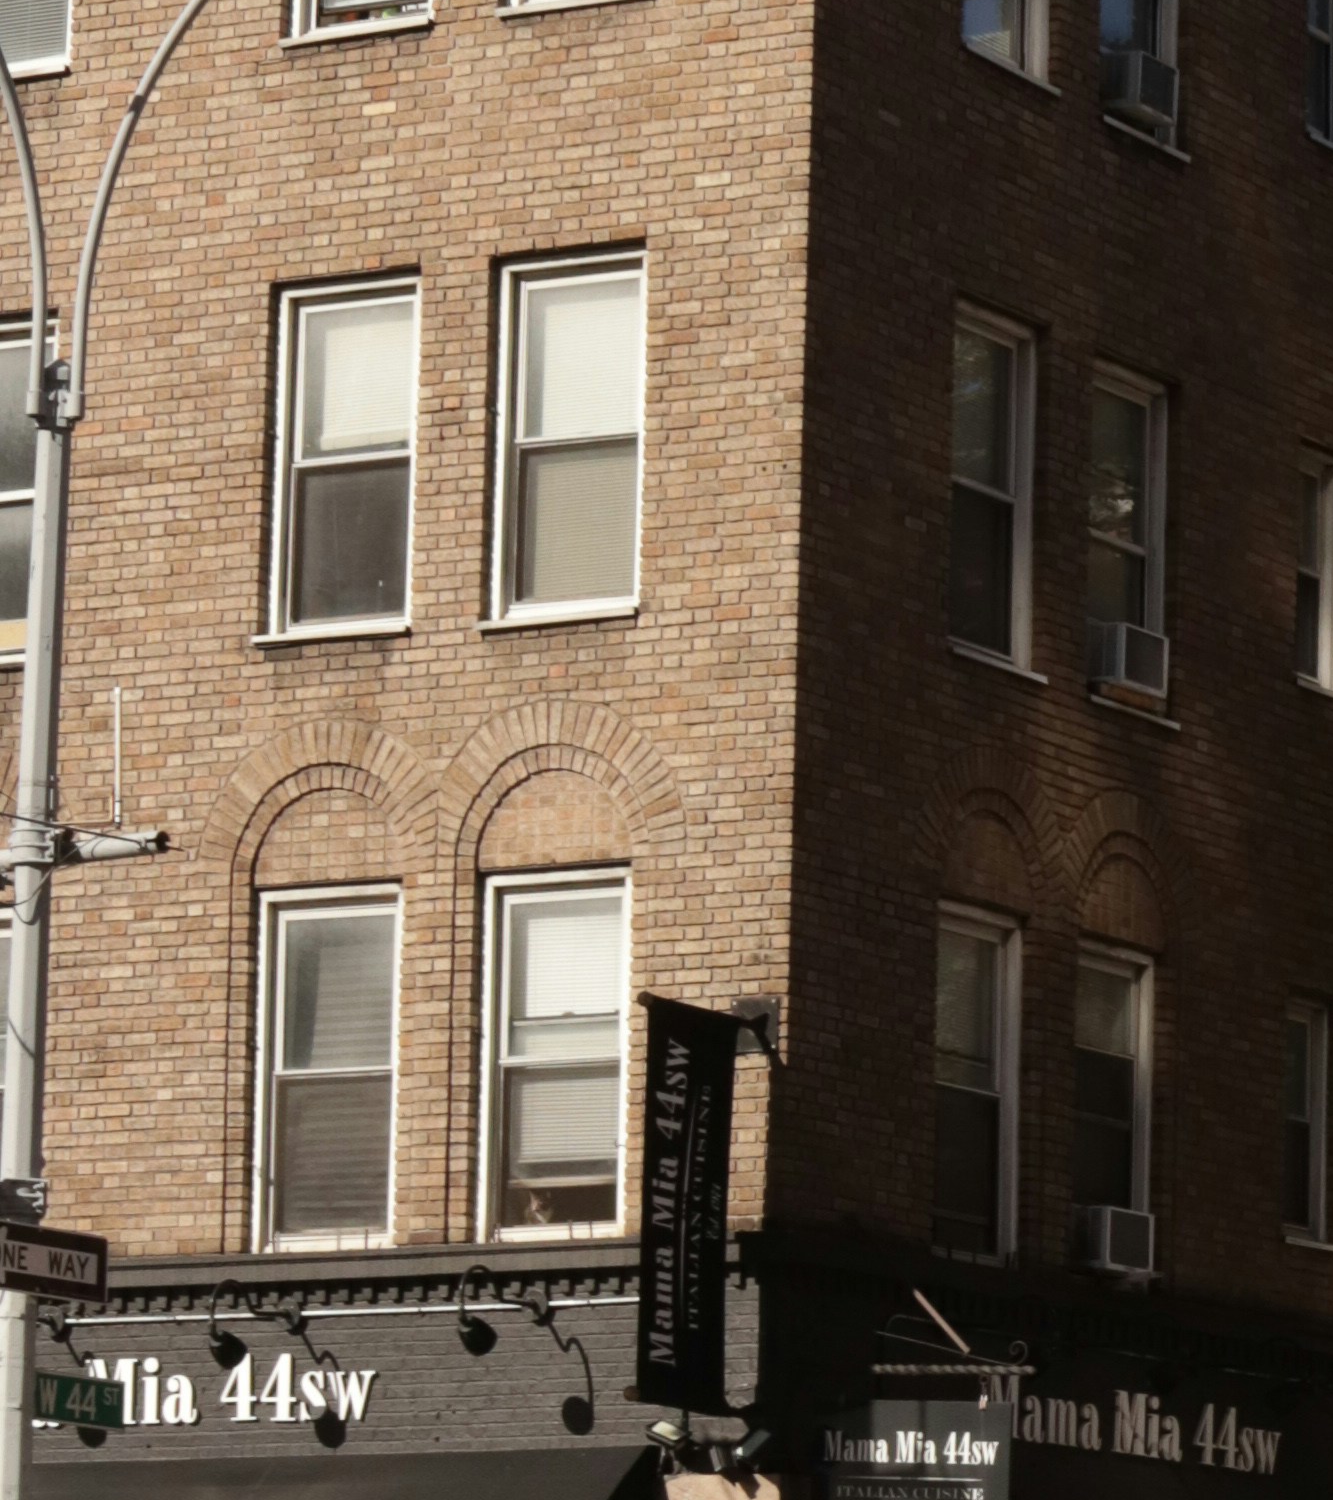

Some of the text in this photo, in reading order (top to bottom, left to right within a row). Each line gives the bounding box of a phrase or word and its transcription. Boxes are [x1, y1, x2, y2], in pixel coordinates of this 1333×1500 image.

[651, 1155, 680, 1232] Mia
[0, 1243, 90, 1281] NE WAY
[688, 1211, 702, 1330] ITALIAN
[648, 1245, 678, 1368] Mama
[39, 1377, 121, 1421] W 44 ST
[990, 1374, 1102, 1452] Mama
[1111, 1388, 1184, 1463] Mia
[823, 1430, 889, 1464] Mama
[895, 1430, 938, 1464] Mia
[836, 1485, 984, 1500] ITALIAN CUISINE
